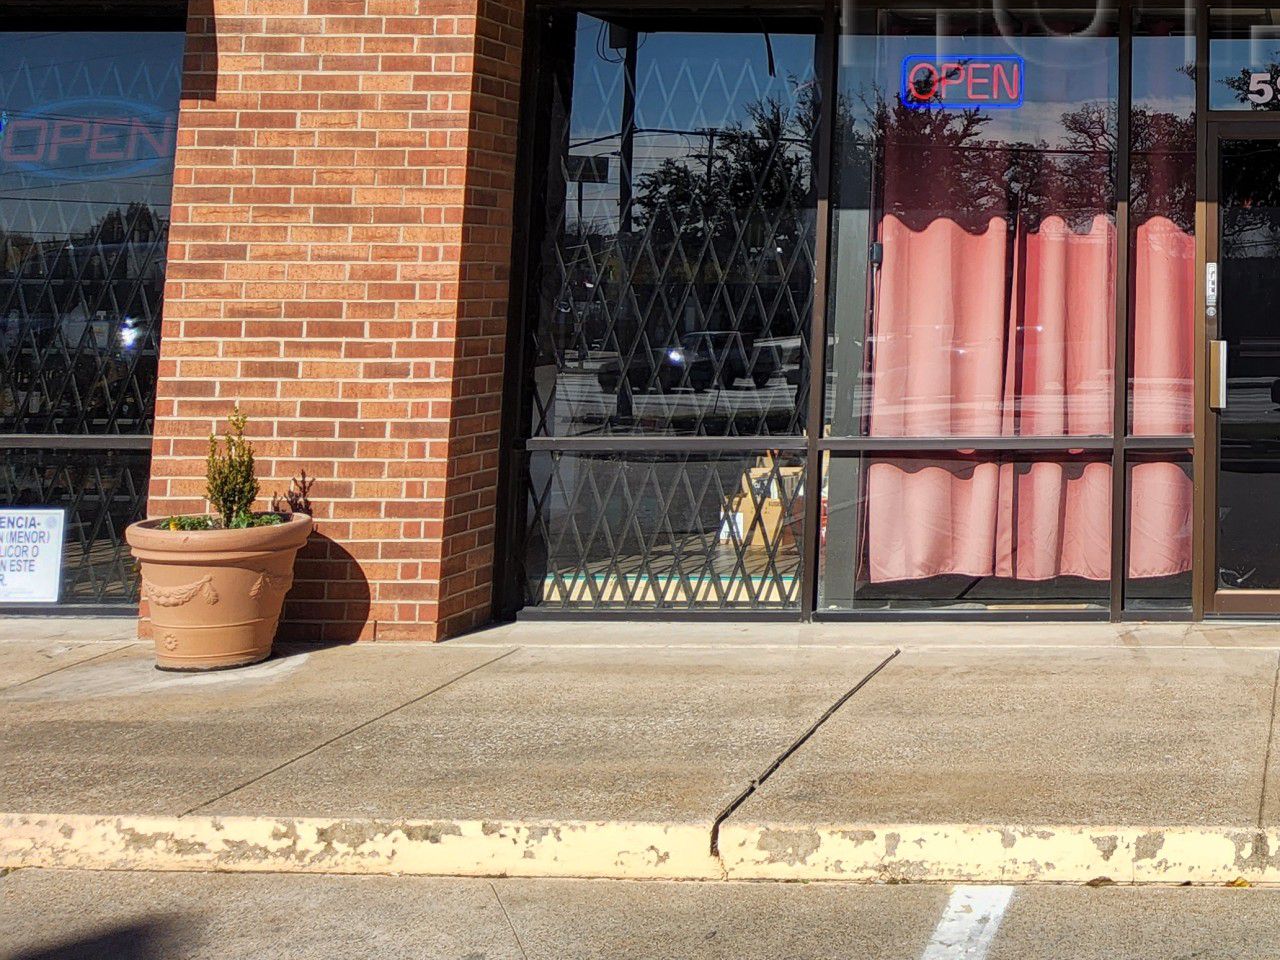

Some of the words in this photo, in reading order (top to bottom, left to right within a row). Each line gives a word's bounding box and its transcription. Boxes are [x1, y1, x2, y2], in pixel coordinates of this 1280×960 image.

[908, 62, 1019, 101] OPEN
[3, 116, 173, 162] OPEN
[9, 559, 35, 572] ESTE
